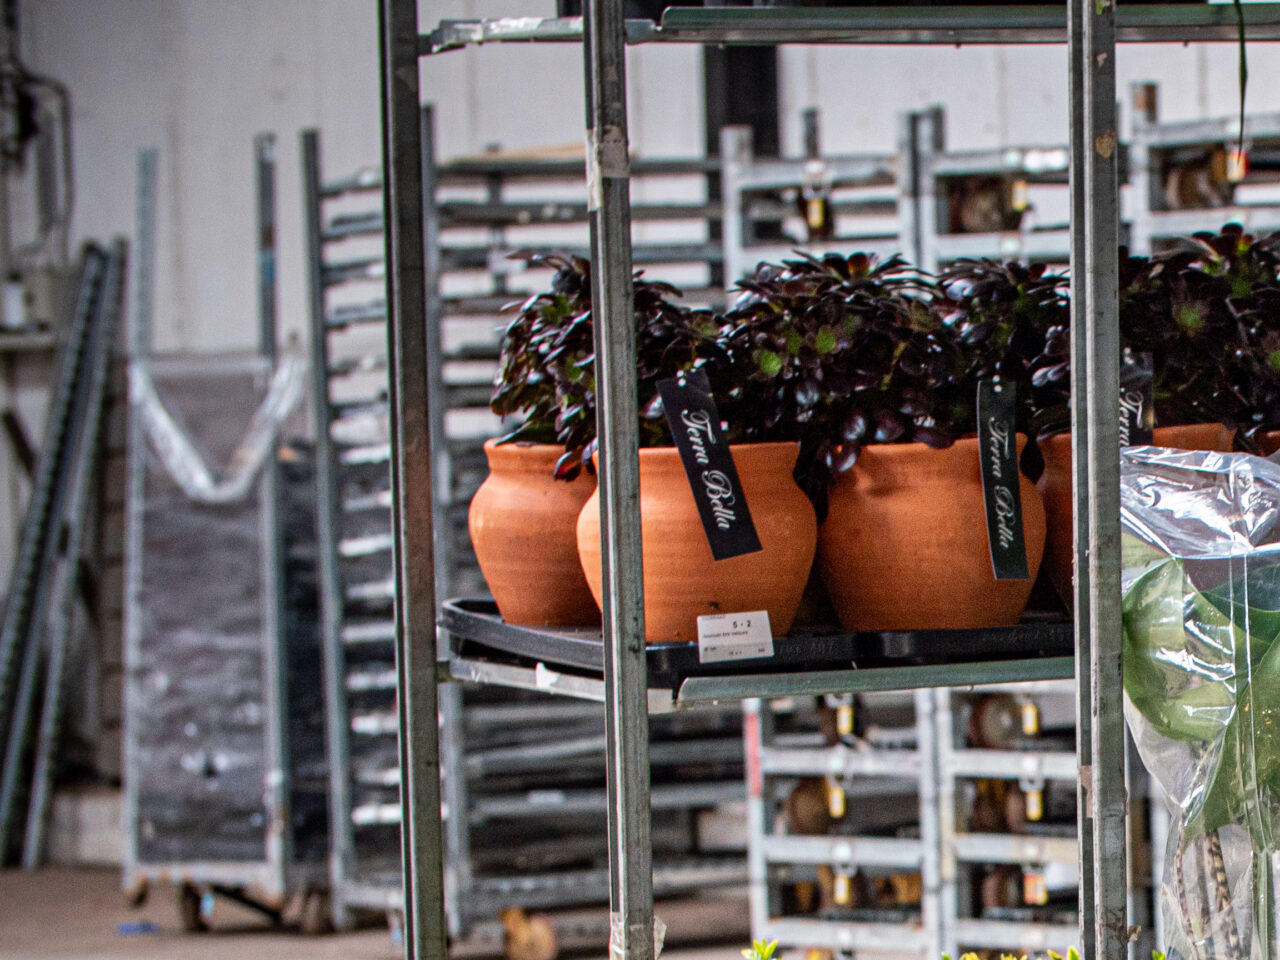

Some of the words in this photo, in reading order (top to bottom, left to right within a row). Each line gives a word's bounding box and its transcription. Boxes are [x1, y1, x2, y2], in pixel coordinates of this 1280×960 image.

[681, 409, 716, 464] Terra
[701, 470, 736, 529] Bella
[988, 417, 1010, 478] Terra
[994, 485, 1015, 548] Bella
